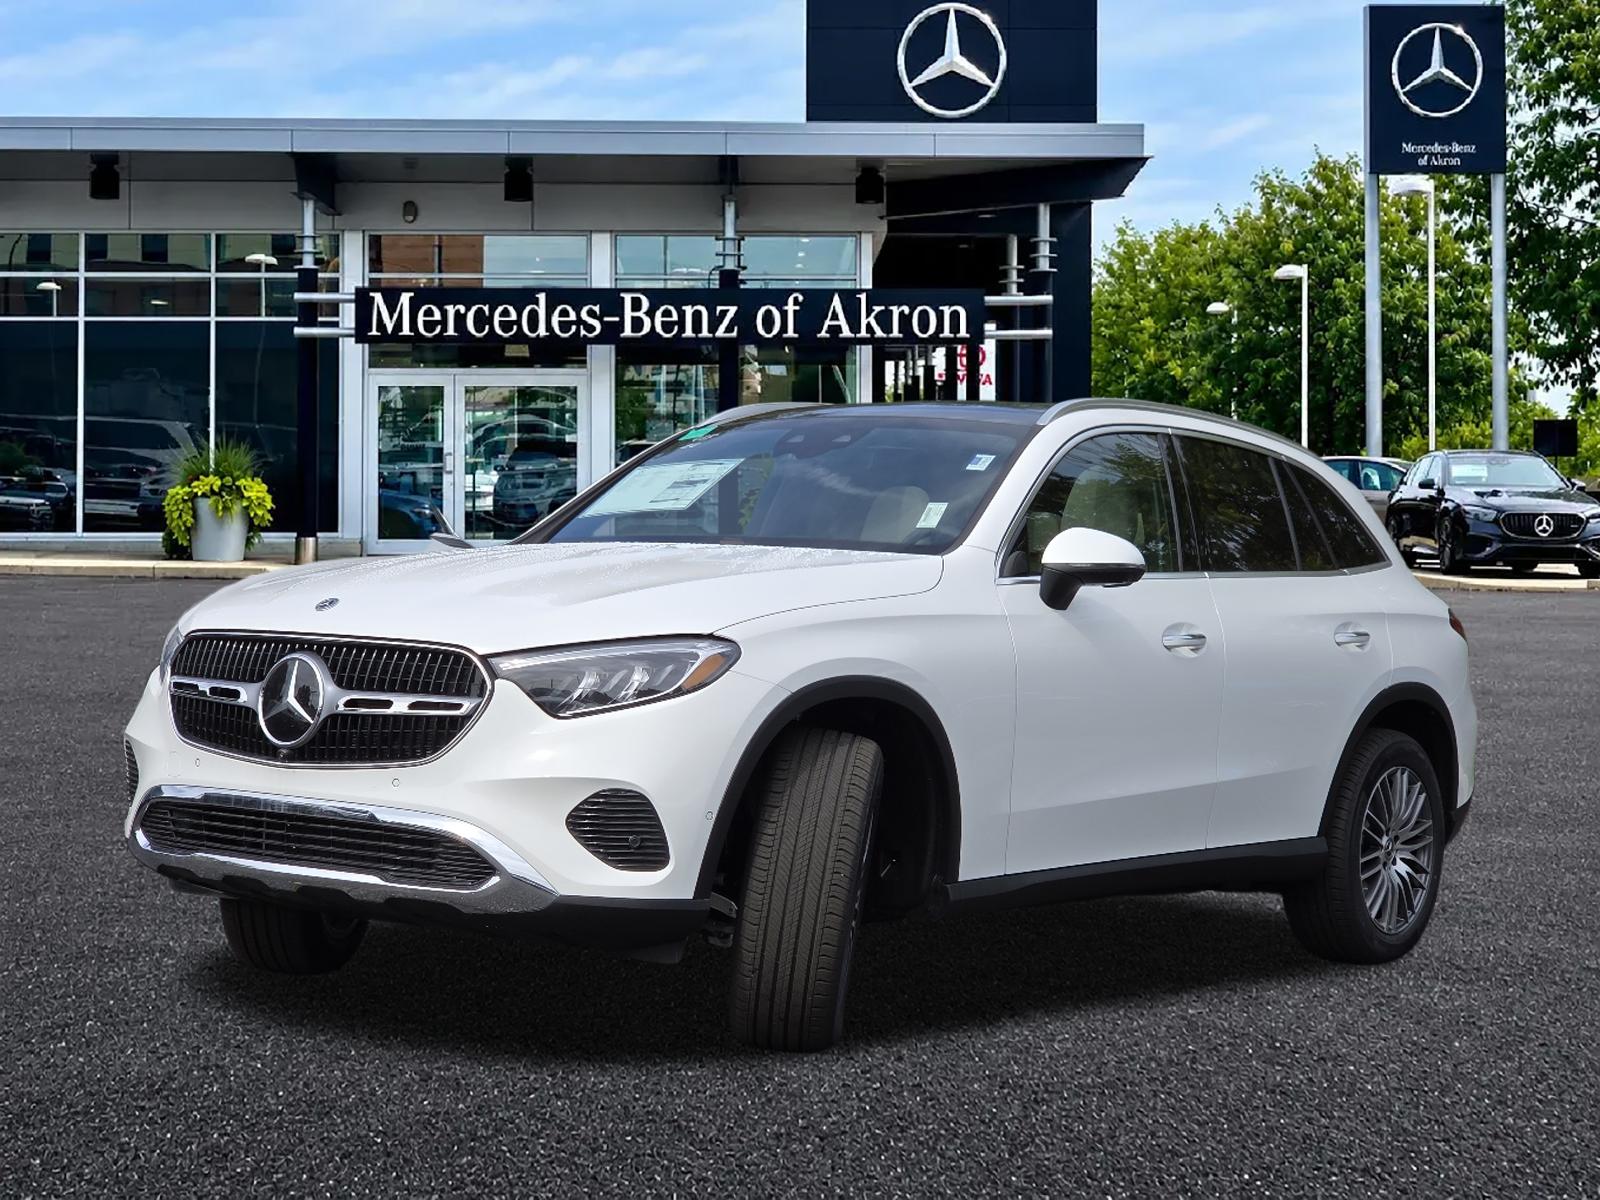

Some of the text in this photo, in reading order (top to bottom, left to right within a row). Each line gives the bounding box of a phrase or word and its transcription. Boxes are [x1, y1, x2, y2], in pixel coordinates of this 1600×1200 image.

[1401, 141, 1476, 154] Mercedes-Benz
[1417, 154, 1461, 166] of Akron
[367, 291, 971, 338] Mercedes-Benz of Akron
